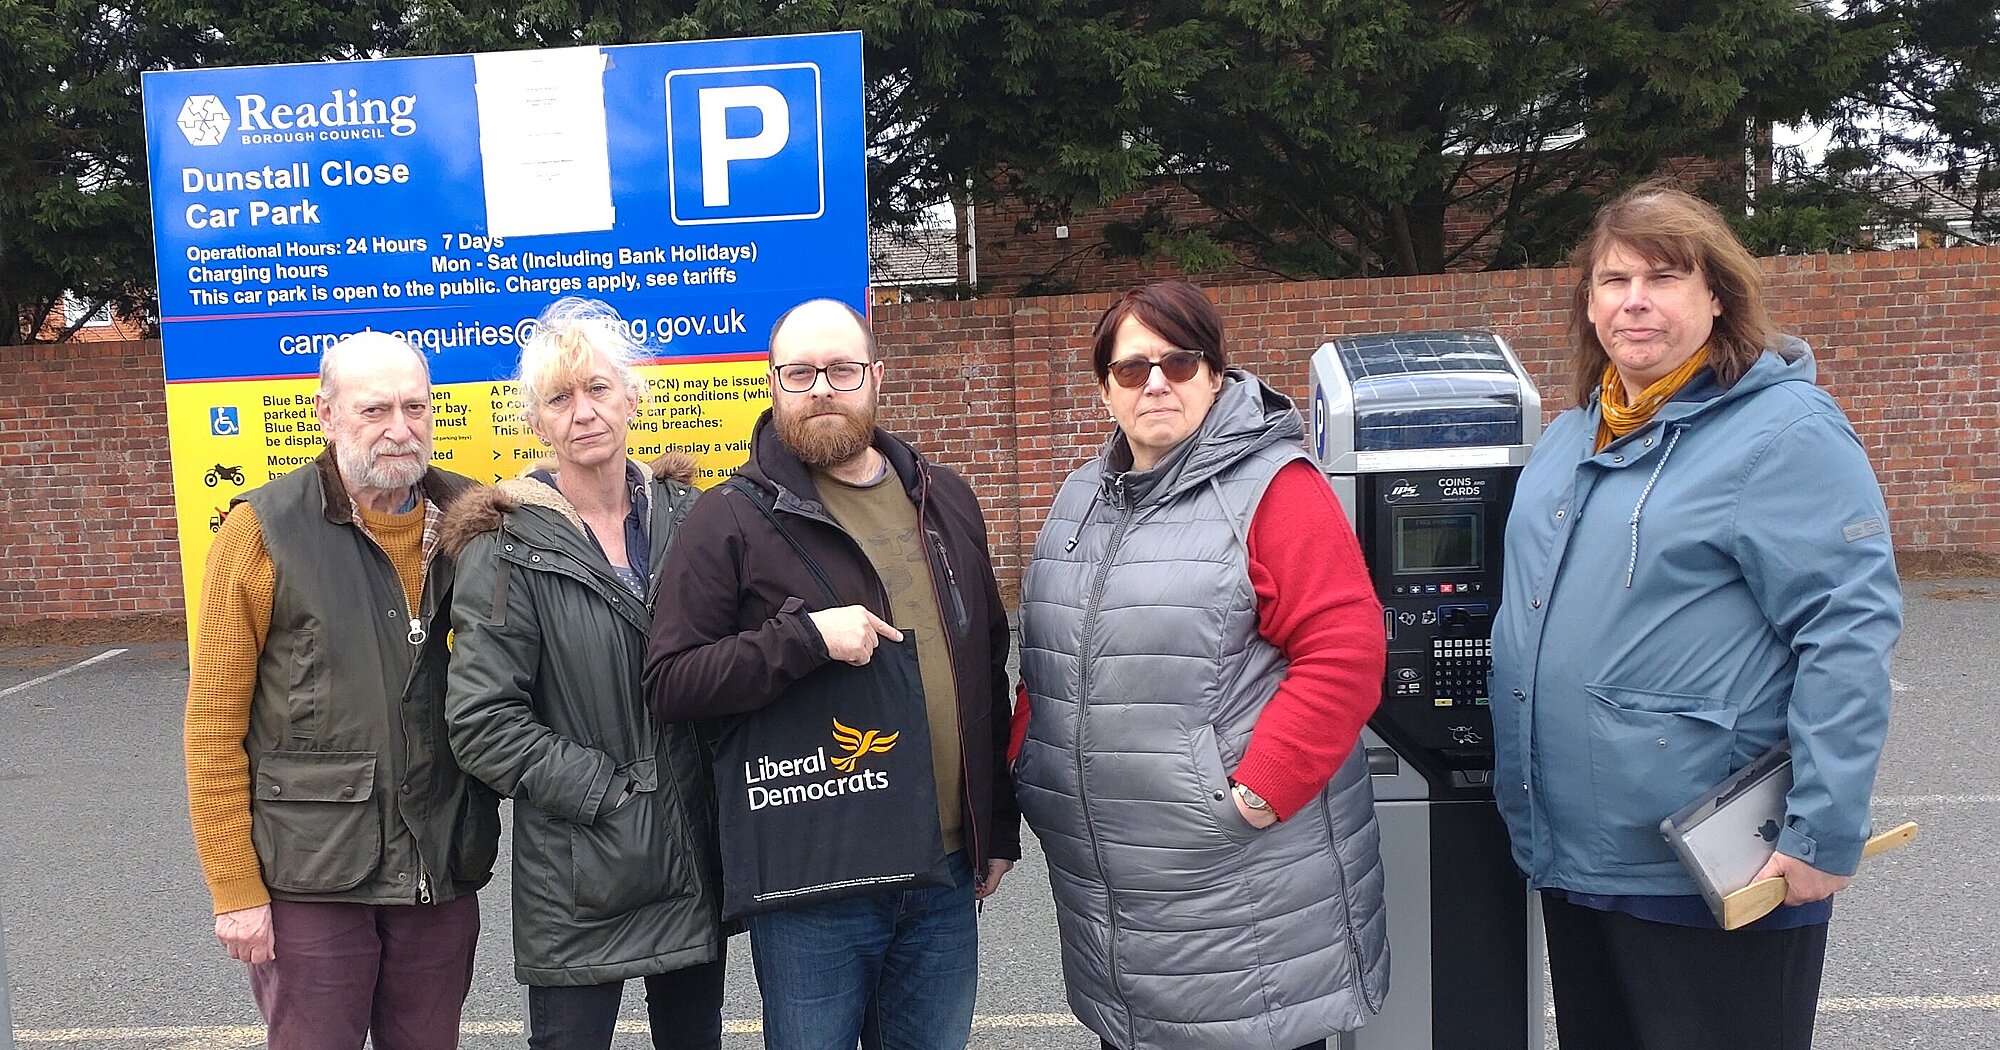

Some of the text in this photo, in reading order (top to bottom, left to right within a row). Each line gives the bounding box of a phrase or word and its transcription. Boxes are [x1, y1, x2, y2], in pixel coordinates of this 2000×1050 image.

[235, 88, 417, 137] Reading
[241, 128, 385, 145] BOROUGH COUNCIL
[699, 85, 789, 207] P
[182, 161, 409, 193] Dunstall Close
[185, 200, 320, 229] Car Park
[187, 233, 504, 263] Operational Hours: 24 Hours 7 Days
[188, 265, 271, 284] Charging
[276, 262, 329, 279] hours
[432, 256, 470, 273] Mon
[487, 253, 518, 271] Sat
[522, 250, 614, 272] (Including
[619, 247, 666, 265] Bank
[671, 241, 757, 262] Holidays)
[189, 267, 737, 306] This car park is open to the public. Charges apply, see tariffs
[490, 386, 500, 396] A
[683, 379, 709, 391] may
[713, 377, 728, 388] be
[263, 395, 291, 406] Blue
[491, 400, 503, 410] to
[674, 390, 739, 402] conditions
[743, 388, 773, 402] (whi
[264, 407, 306, 422] parked
[445, 403, 471, 415] bay.
[647, 408, 666, 417] car
[670, 404, 705, 418] park).
[265, 422, 293, 433] Blue
[435, 416, 467, 427] must
[662, 417, 723, 430] breaches:
[266, 434, 328, 448] be display
[513, 448, 556, 460] Failure
[638, 444, 661, 455] and
[665, 442, 710, 455] display
[714, 443, 721, 451] a
[695, 467, 714, 478] he
[1438, 478, 1471, 487] COINS
[1443, 487, 1480, 496] CARDS
[745, 747, 826, 784] Liberal
[748, 768, 889, 811] Democrats
